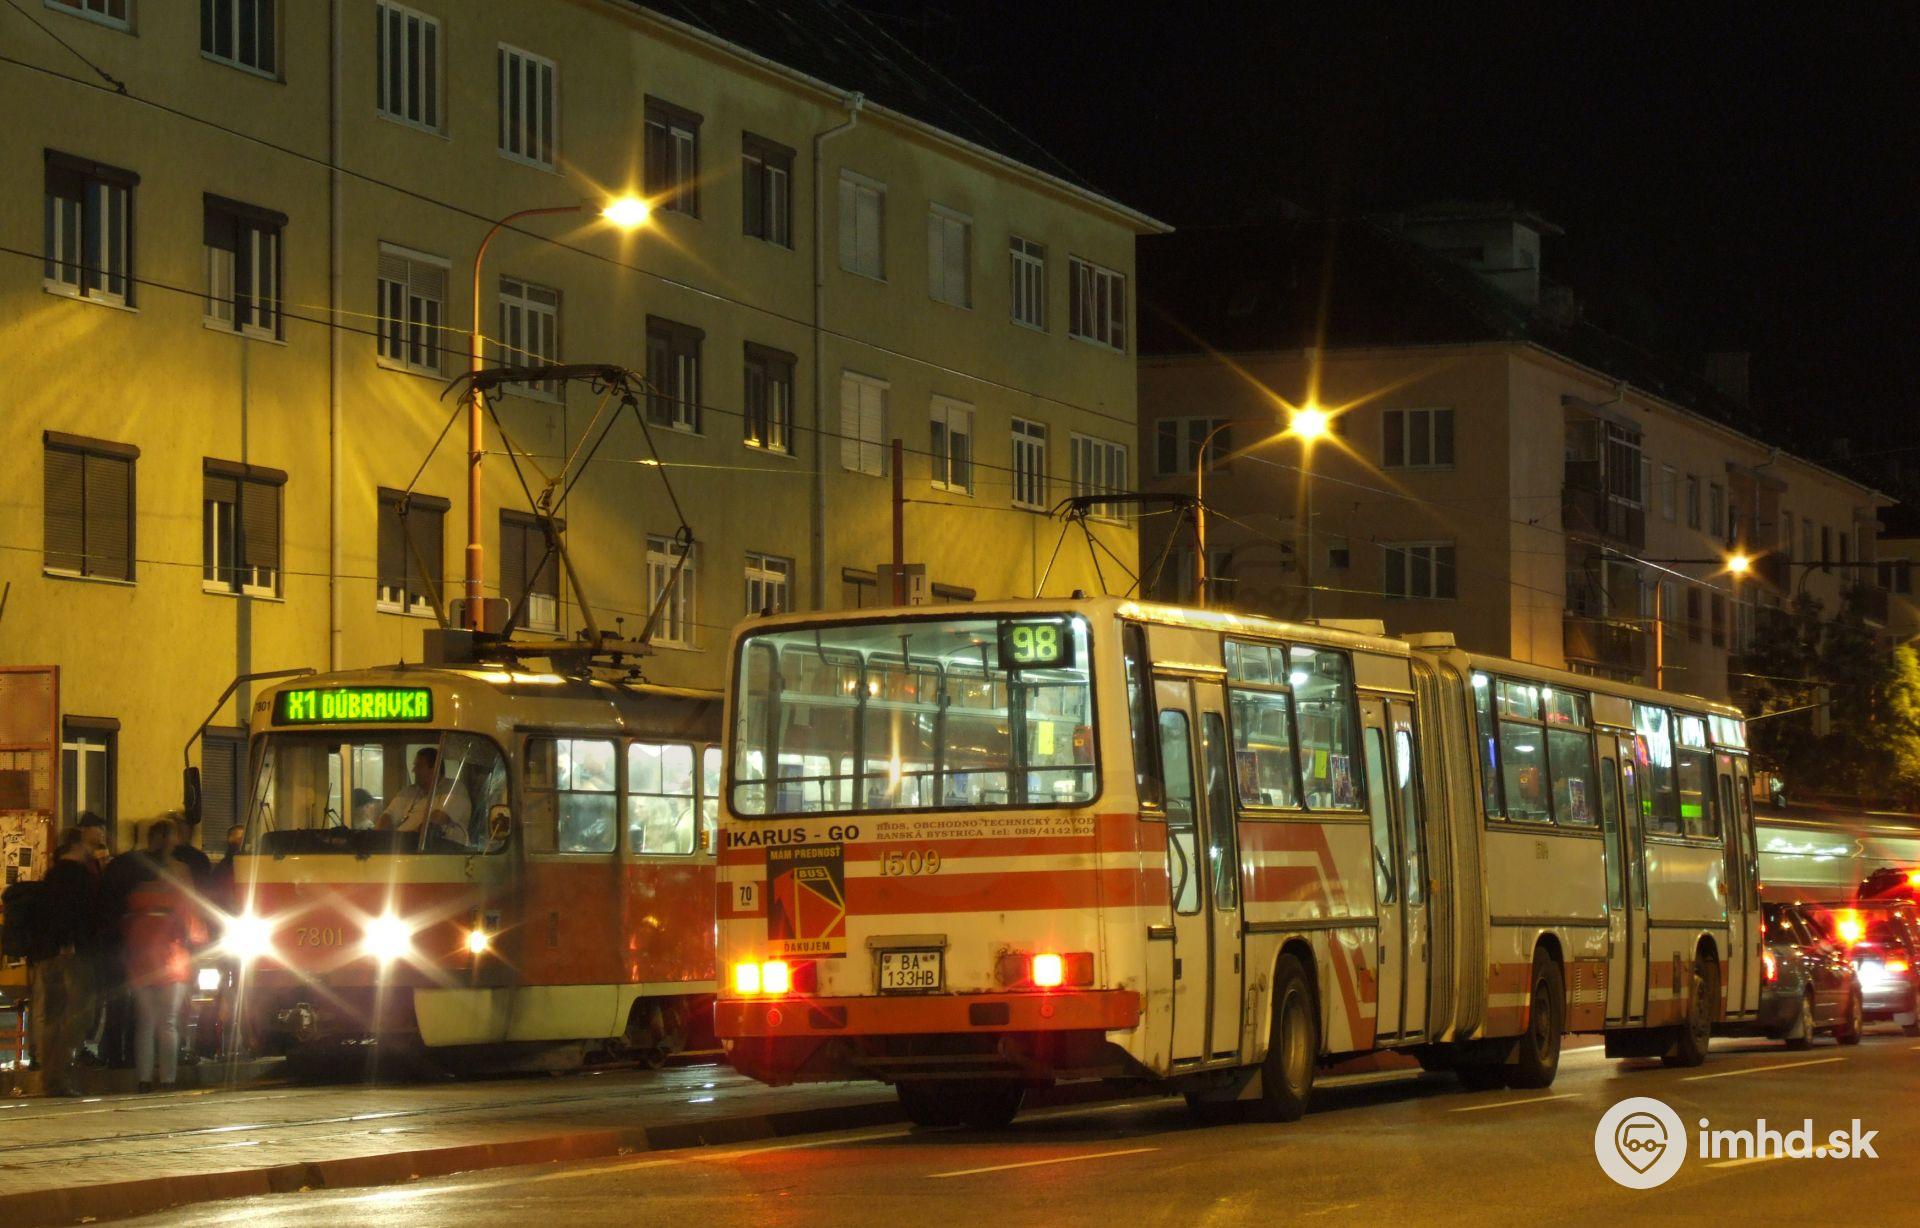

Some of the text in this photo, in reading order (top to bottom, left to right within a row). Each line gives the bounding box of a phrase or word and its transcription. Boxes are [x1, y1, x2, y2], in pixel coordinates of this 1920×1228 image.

[1012, 625, 1058, 662] 98
[289, 689, 428, 720] X1 DÚBRAVKA
[727, 827, 807, 848] IKARUS
[828, 825, 860, 841] GO
[879, 849, 942, 876] 1509
[799, 869, 825, 878] BUS
[740, 886, 752, 901] 70
[296, 927, 344, 947] 7801
[901, 955, 920, 970] BA
[888, 970, 934, 986] 133HB
